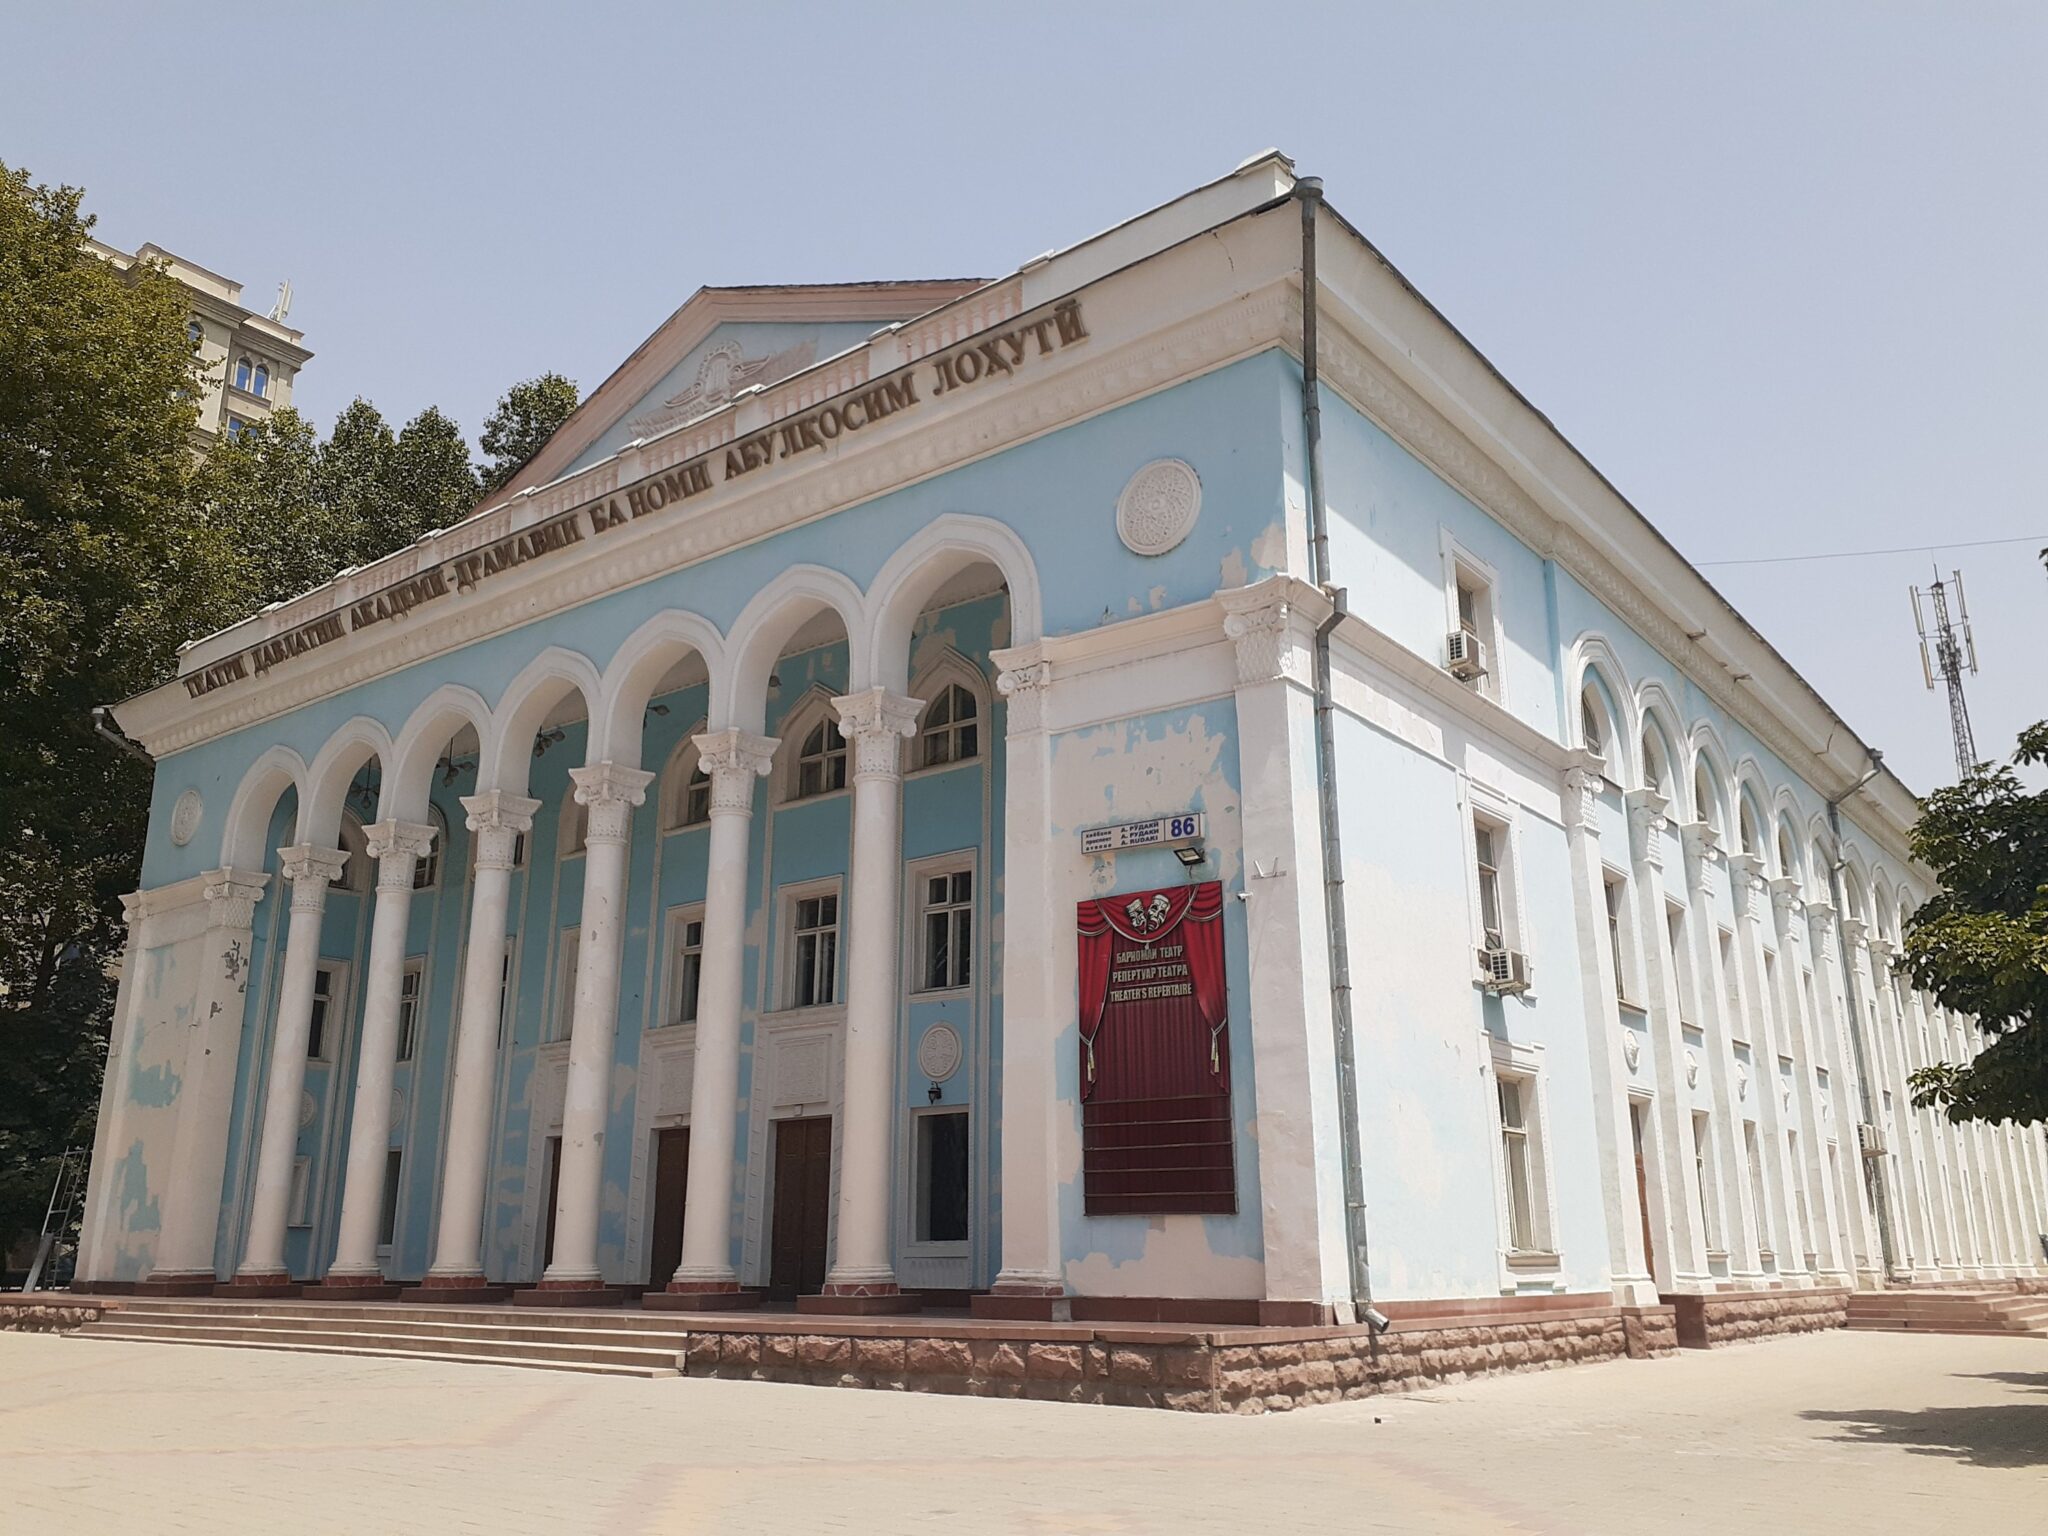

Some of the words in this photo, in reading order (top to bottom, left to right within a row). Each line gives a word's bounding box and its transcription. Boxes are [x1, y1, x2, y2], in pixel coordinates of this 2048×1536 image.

[182, 656, 249, 699] ТЕАТРИ
[588, 500, 629, 536] БА
[627, 460, 714, 519] НОМИ
[724, 371, 921, 481] АБУЛҚОСИМ
[932, 299, 1090, 396] ЛОҲУТӢ
[1171, 817, 1195, 838] 86
[1129, 836, 1159, 845] RUDAKI
[1160, 945, 1183, 958] ТЕАТР
[1112, 967, 1157, 983] РЕПЕРТУАР
[1158, 964, 1188, 978] ТЕАТРА
[1148, 983, 1192, 998] REPERTAIRE
